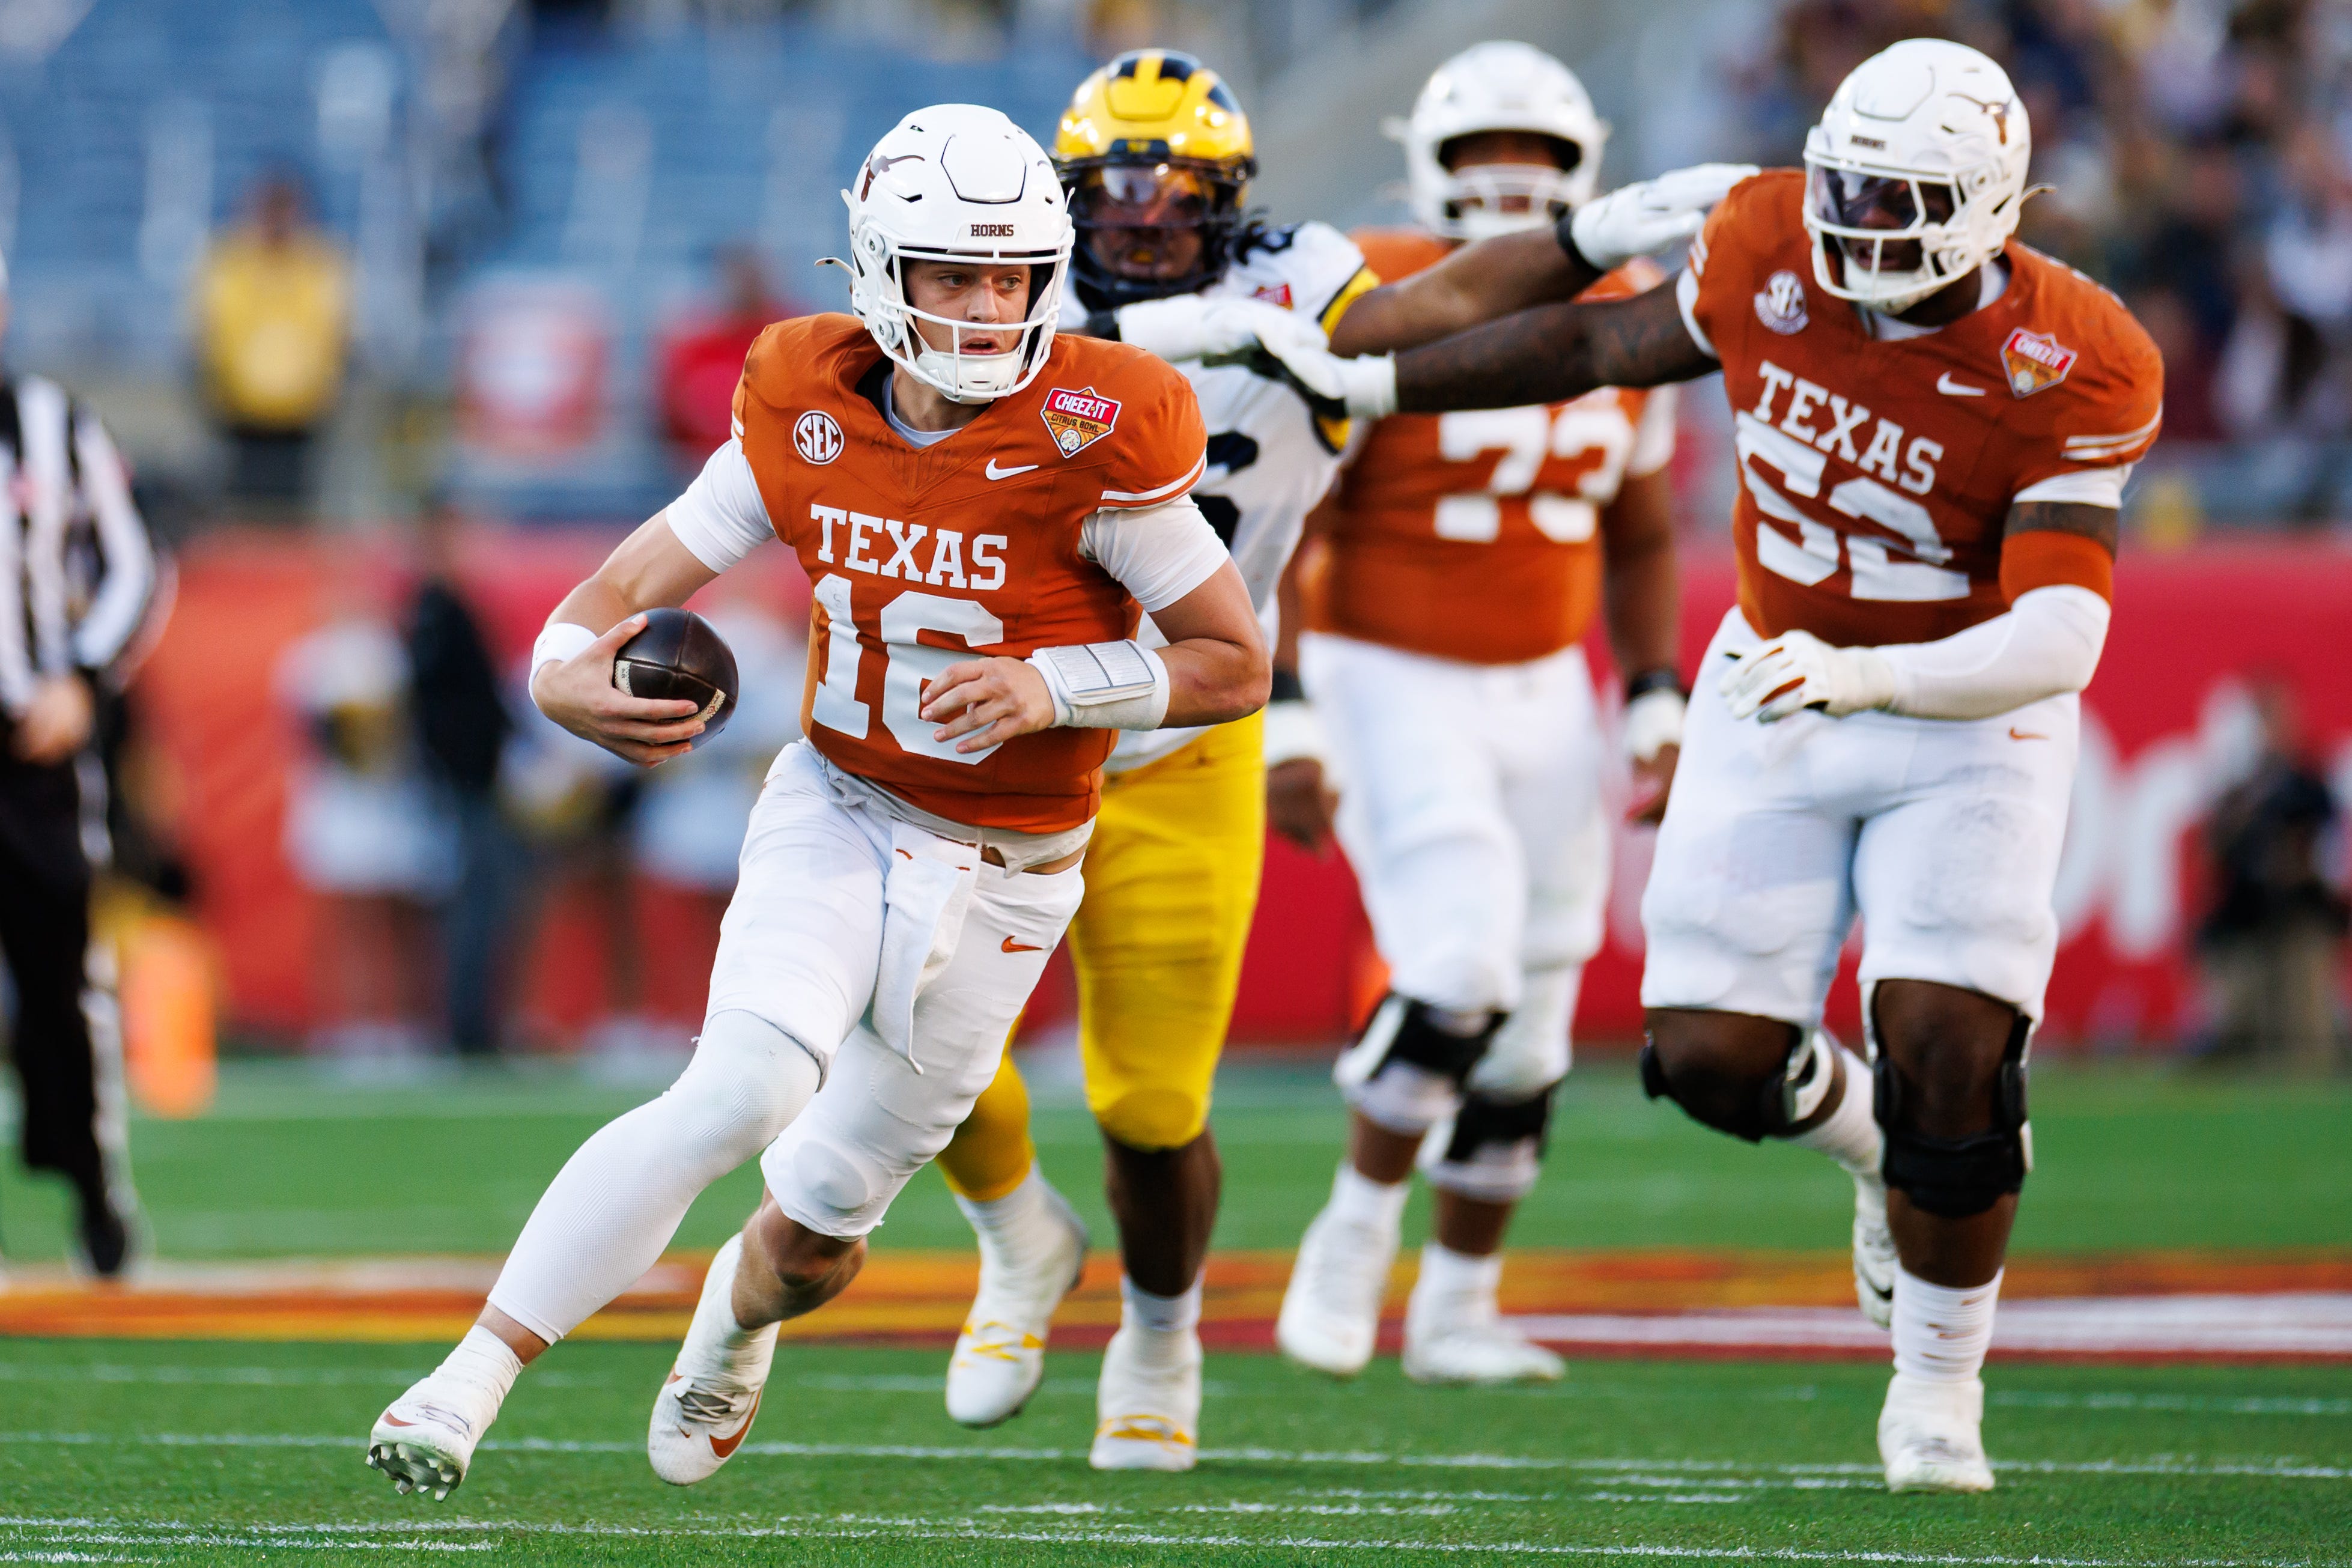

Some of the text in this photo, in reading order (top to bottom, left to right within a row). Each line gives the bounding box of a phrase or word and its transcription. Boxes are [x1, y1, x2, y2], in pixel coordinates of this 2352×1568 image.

[970, 224, 1014, 237] HORNS
[798, 415, 839, 461] SEC
[1051, 413, 1099, 433] CITRUS BOWL
[1434, 404, 1635, 544] 73
[1752, 360, 1943, 495] TEXAS
[810, 503, 1008, 590] TEXAS
[1736, 409, 1971, 601] 52
[811, 573, 1004, 765] 16
